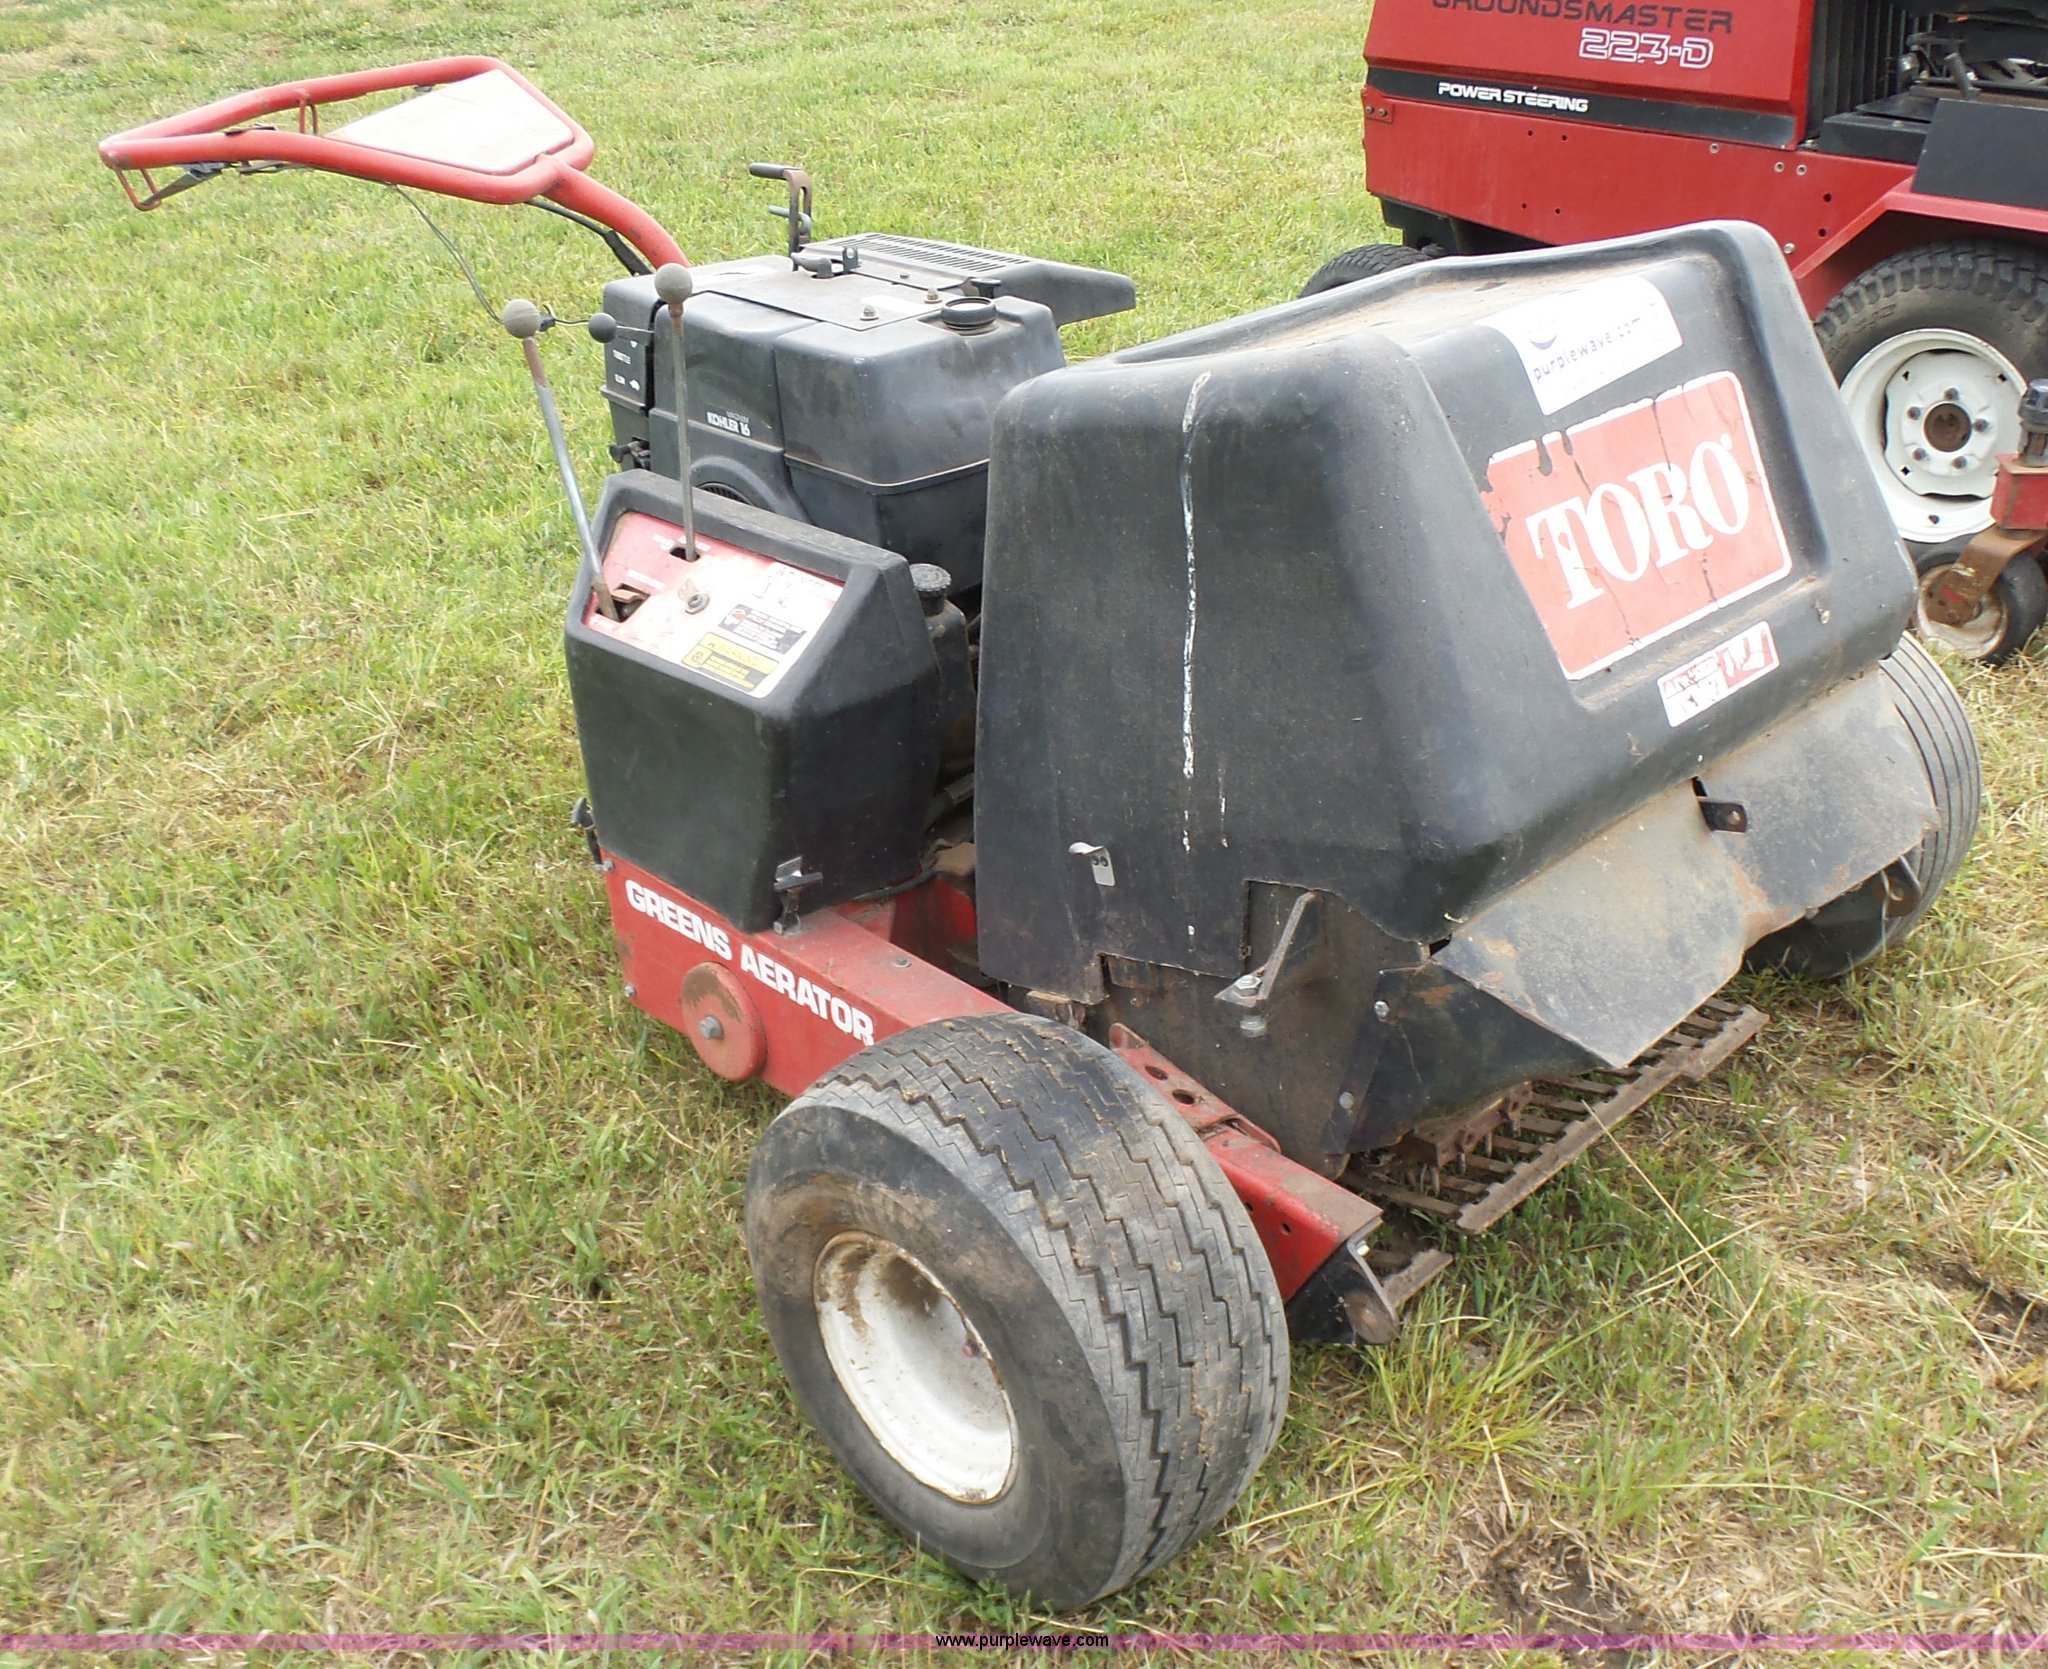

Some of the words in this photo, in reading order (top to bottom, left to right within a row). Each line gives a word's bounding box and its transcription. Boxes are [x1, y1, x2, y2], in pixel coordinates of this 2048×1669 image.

[1438, 81, 1502, 102] POWER
[1502, 88, 1589, 113] STEERING
[1578, 27, 1714, 69] 223-D
[1525, 439, 1750, 609] TORO
[625, 879, 733, 961] GREENS
[740, 943, 875, 1047] AERATOR
